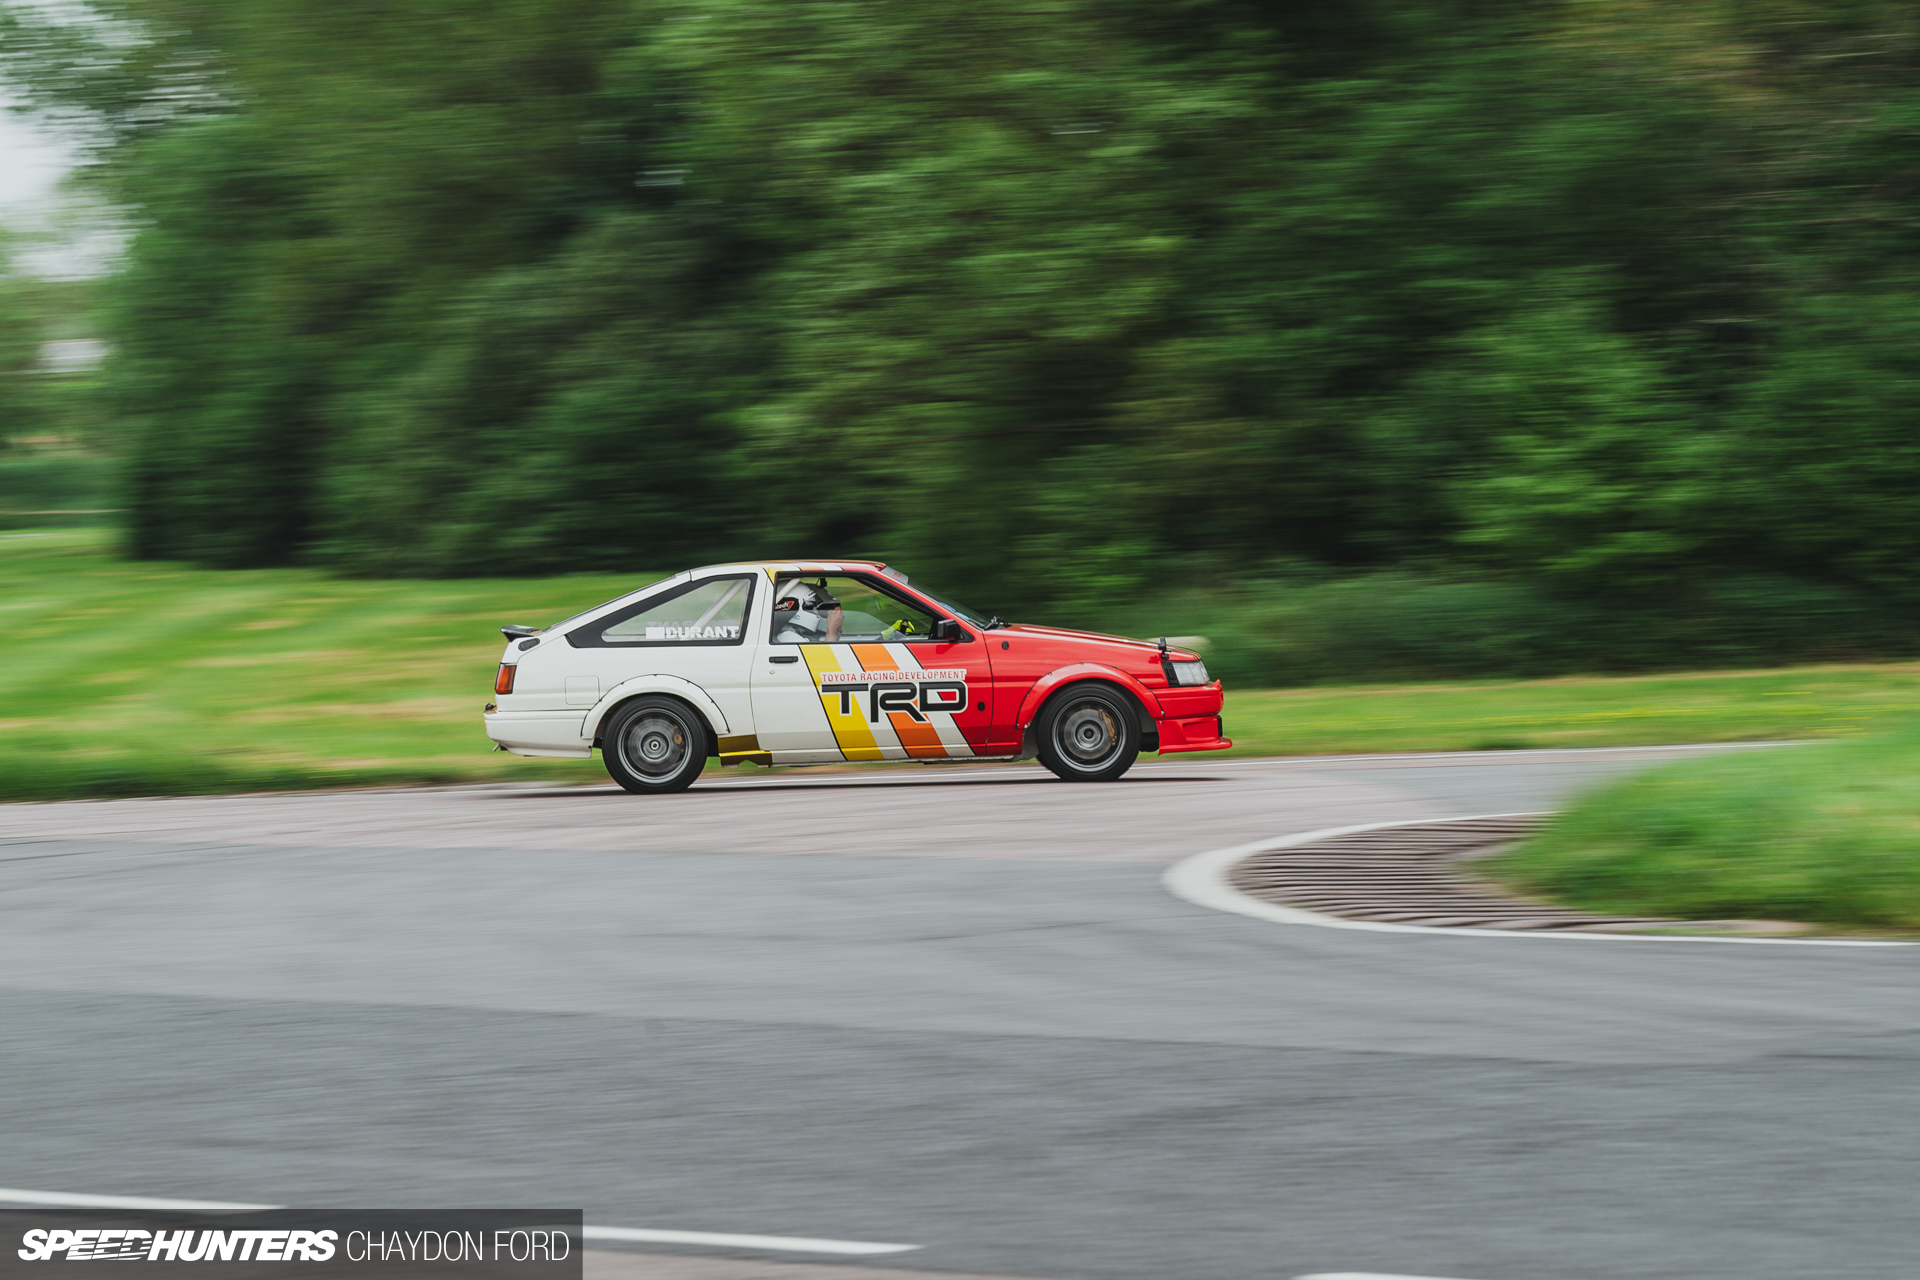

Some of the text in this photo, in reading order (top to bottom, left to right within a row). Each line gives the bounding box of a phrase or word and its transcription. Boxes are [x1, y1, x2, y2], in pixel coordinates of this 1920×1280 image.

[665, 626, 739, 639] DURANT
[822, 670, 965, 682] TOYOTA RACING DEVELOPMENT
[821, 681, 967, 723] TRD
